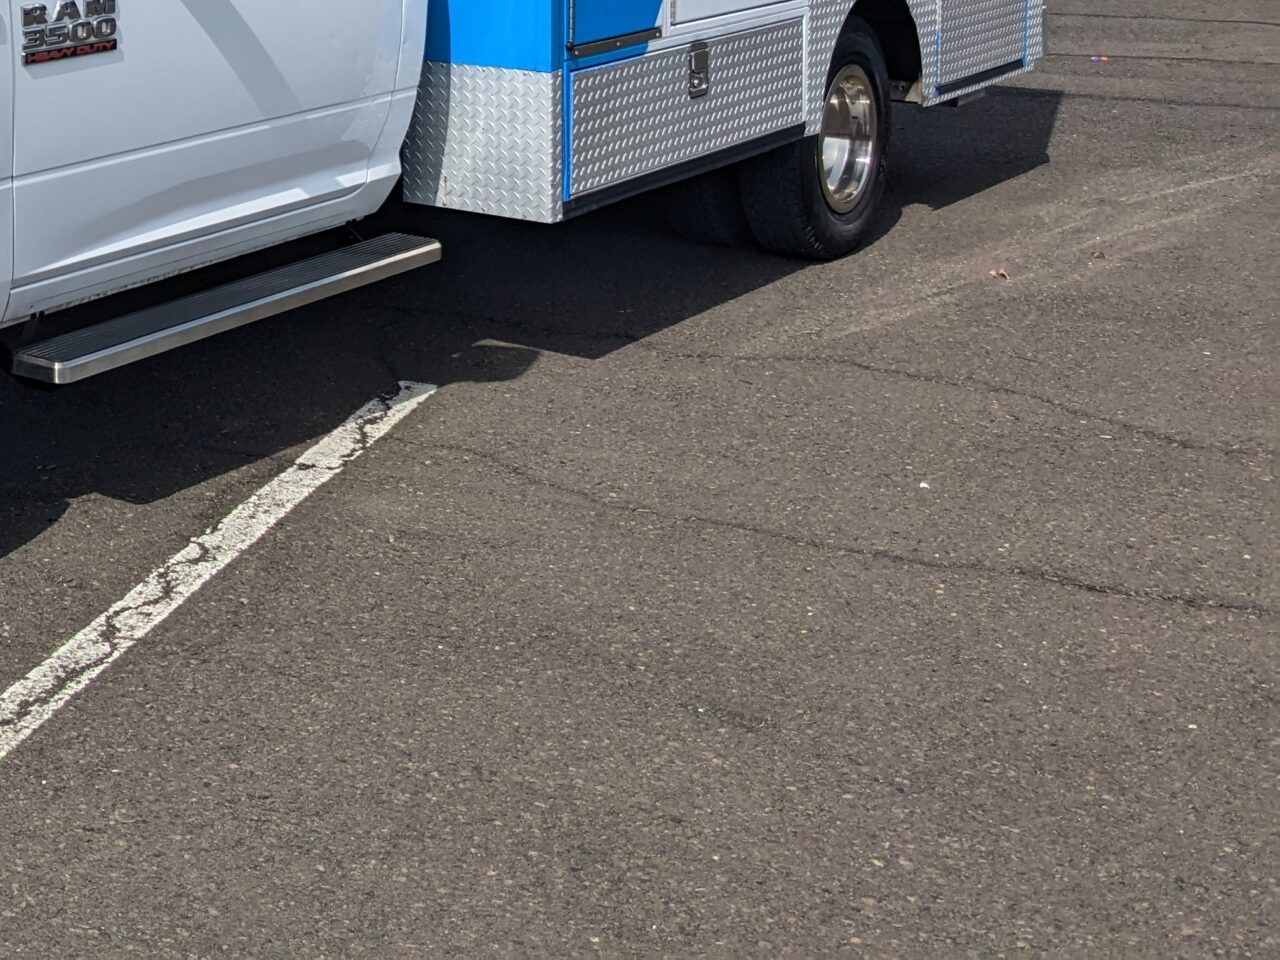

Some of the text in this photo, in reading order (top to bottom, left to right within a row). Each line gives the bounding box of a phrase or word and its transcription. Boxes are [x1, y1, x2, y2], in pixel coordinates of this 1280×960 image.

[21, 15, 117, 51] 3500
[27, 40, 114, 63] HEAVY DUTY
